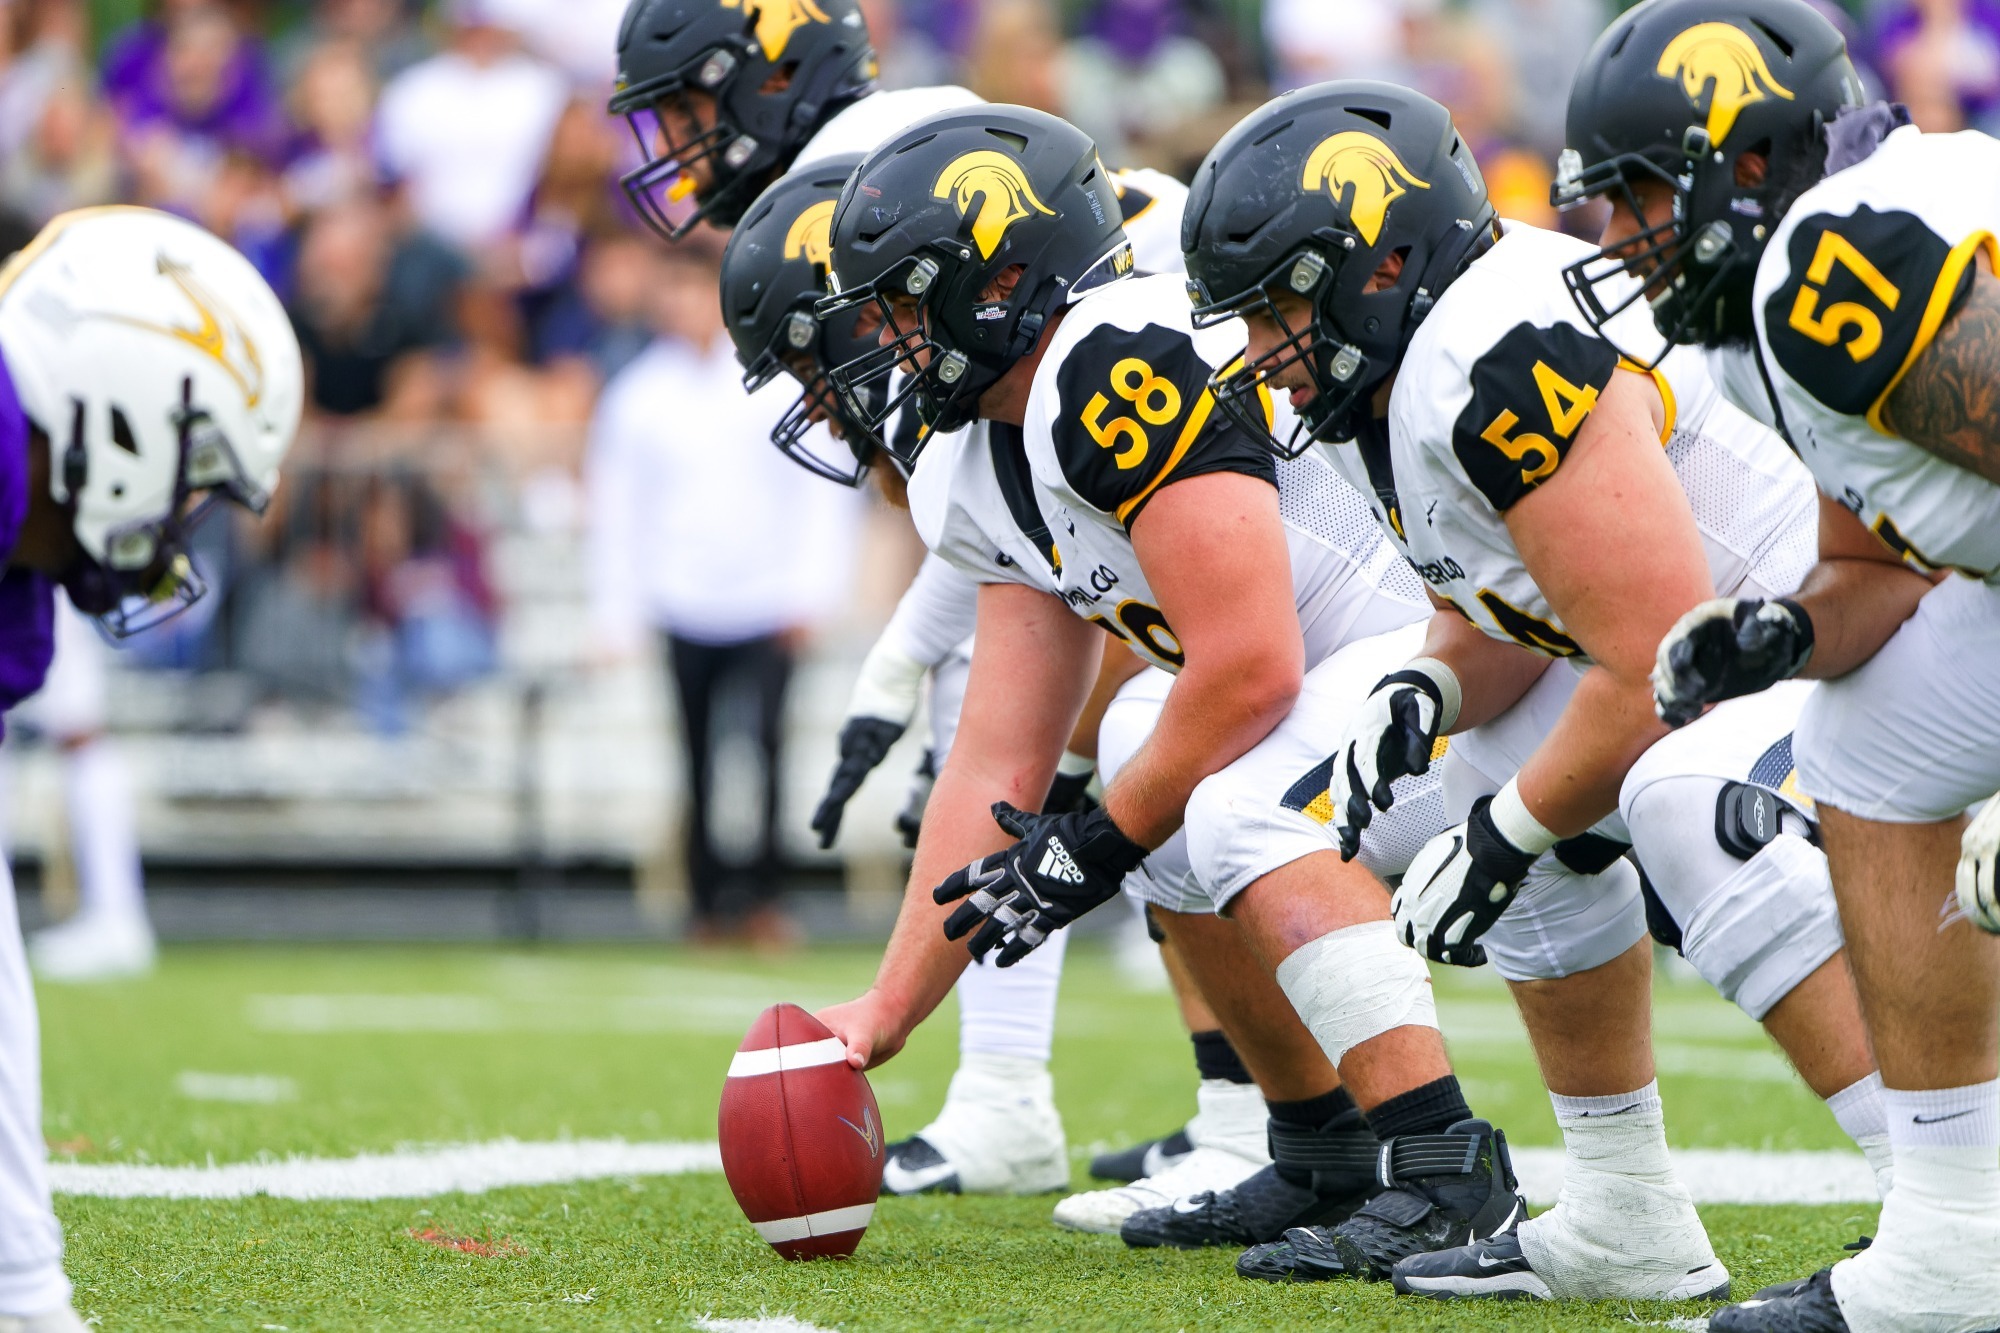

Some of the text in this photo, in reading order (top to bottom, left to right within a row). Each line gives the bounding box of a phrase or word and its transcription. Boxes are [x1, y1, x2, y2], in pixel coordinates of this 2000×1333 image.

[1788, 229, 1901, 363] 57
[1080, 357, 1182, 470] 58
[1480, 359, 1599, 485] 54
[1047, 835, 1085, 884] adidas
